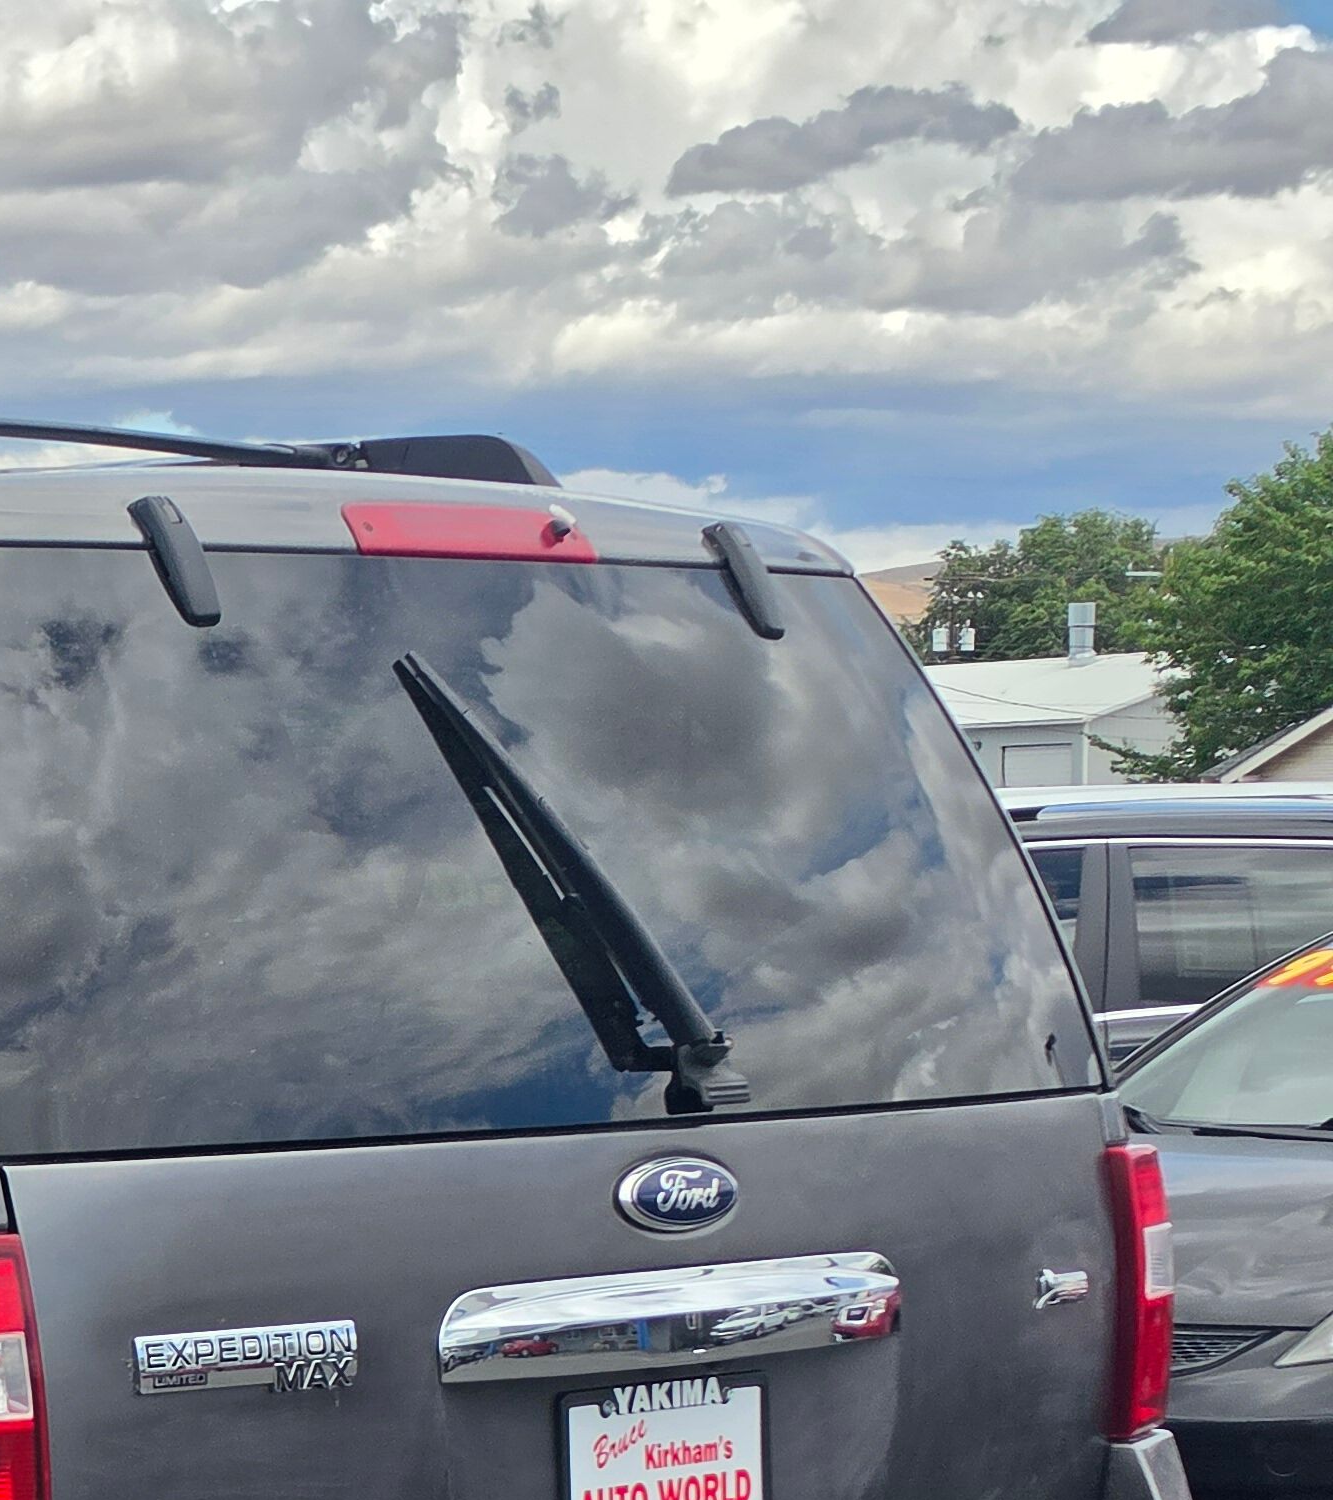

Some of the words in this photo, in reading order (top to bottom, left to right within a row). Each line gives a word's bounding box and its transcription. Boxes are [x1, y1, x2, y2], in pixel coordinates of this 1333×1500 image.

[657, 1170, 720, 1212] Ford
[143, 1326, 353, 1370] EXPEDITION
[154, 1373, 207, 1388] LIMITED
[274, 1357, 353, 1392] MAX
[613, 1376, 724, 1416] YAKIMA
[593, 1418, 648, 1469] Bruce
[644, 1435, 733, 1470] Kirkham's
